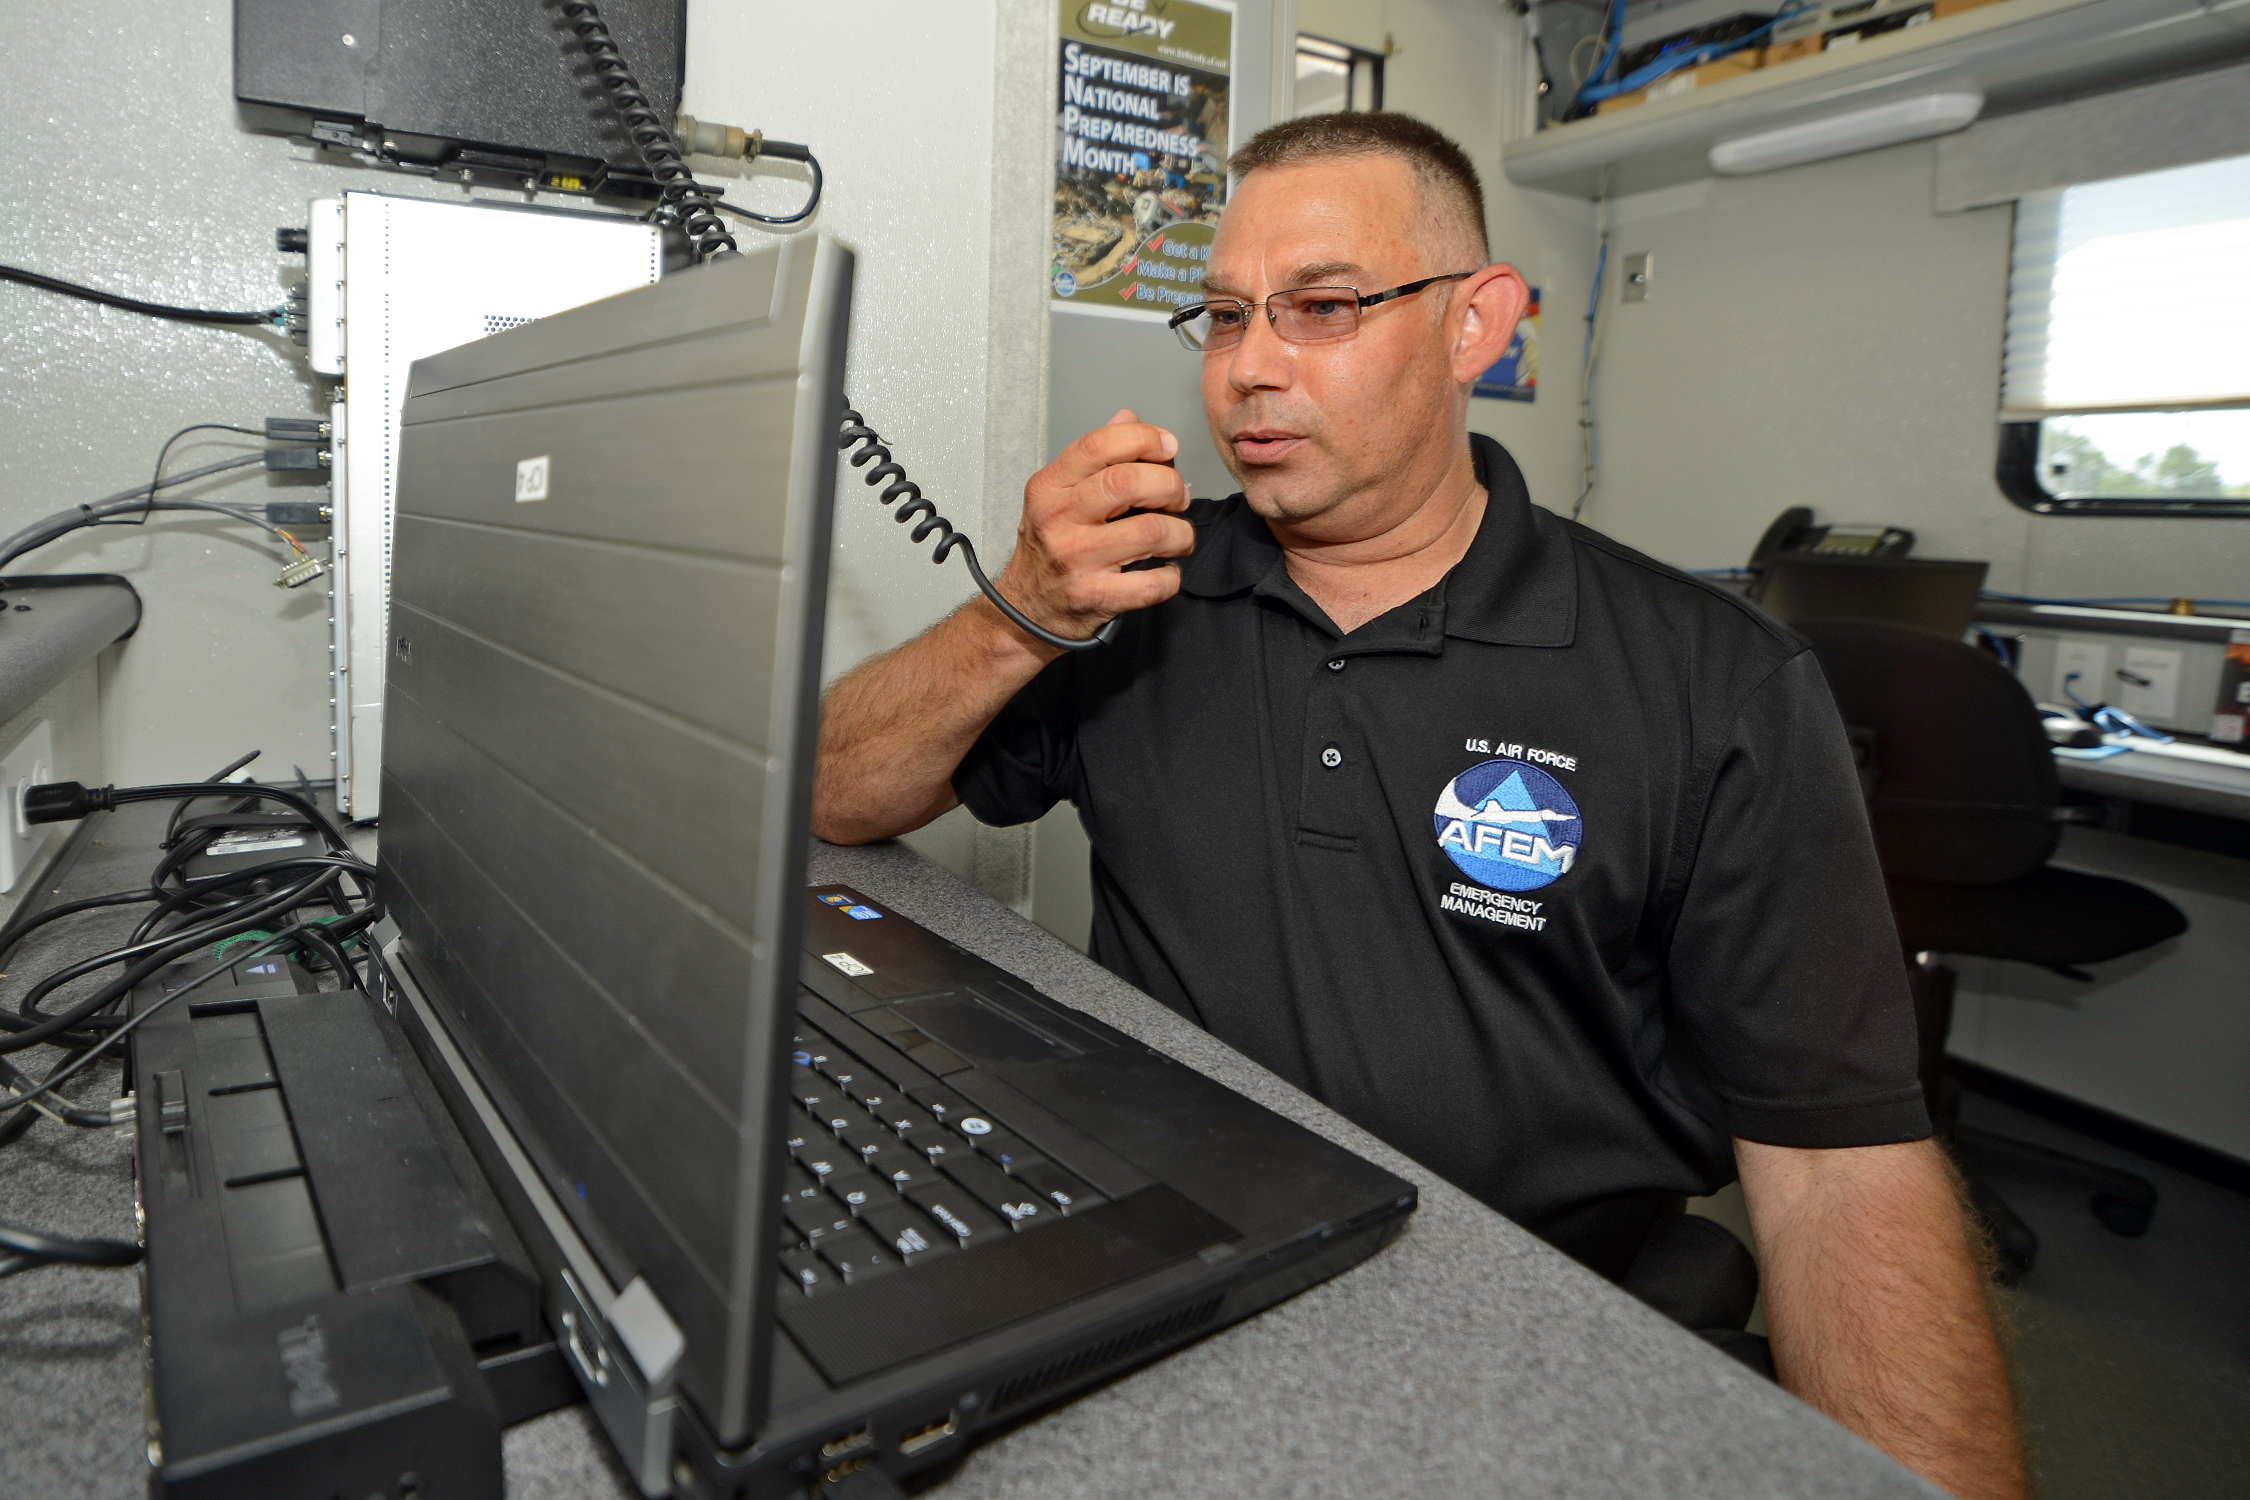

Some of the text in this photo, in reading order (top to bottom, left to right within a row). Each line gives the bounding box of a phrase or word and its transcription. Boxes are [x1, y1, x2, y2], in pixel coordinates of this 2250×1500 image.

[1087, 2, 1175, 39] READY
[1064, 43, 1191, 96] SEPTEMBER IS
[1064, 74, 1161, 120] NATIONAL
[1063, 104, 1200, 157] PREPAREDNESS
[1062, 135, 1137, 175] MONTH
[1163, 240, 1187, 259] Get
[1189, 247, 1198, 260] a
[1137, 260, 1175, 280] Make
[1178, 269, 1187, 281] a
[1136, 284, 1154, 301] Be
[1466, 738, 1578, 772] U.S. AIR FORCE
[1437, 819, 1577, 874] AFEM
[1441, 895, 1546, 931] MANAGEMENT
[1450, 882, 1543, 915] EMERGENCY
